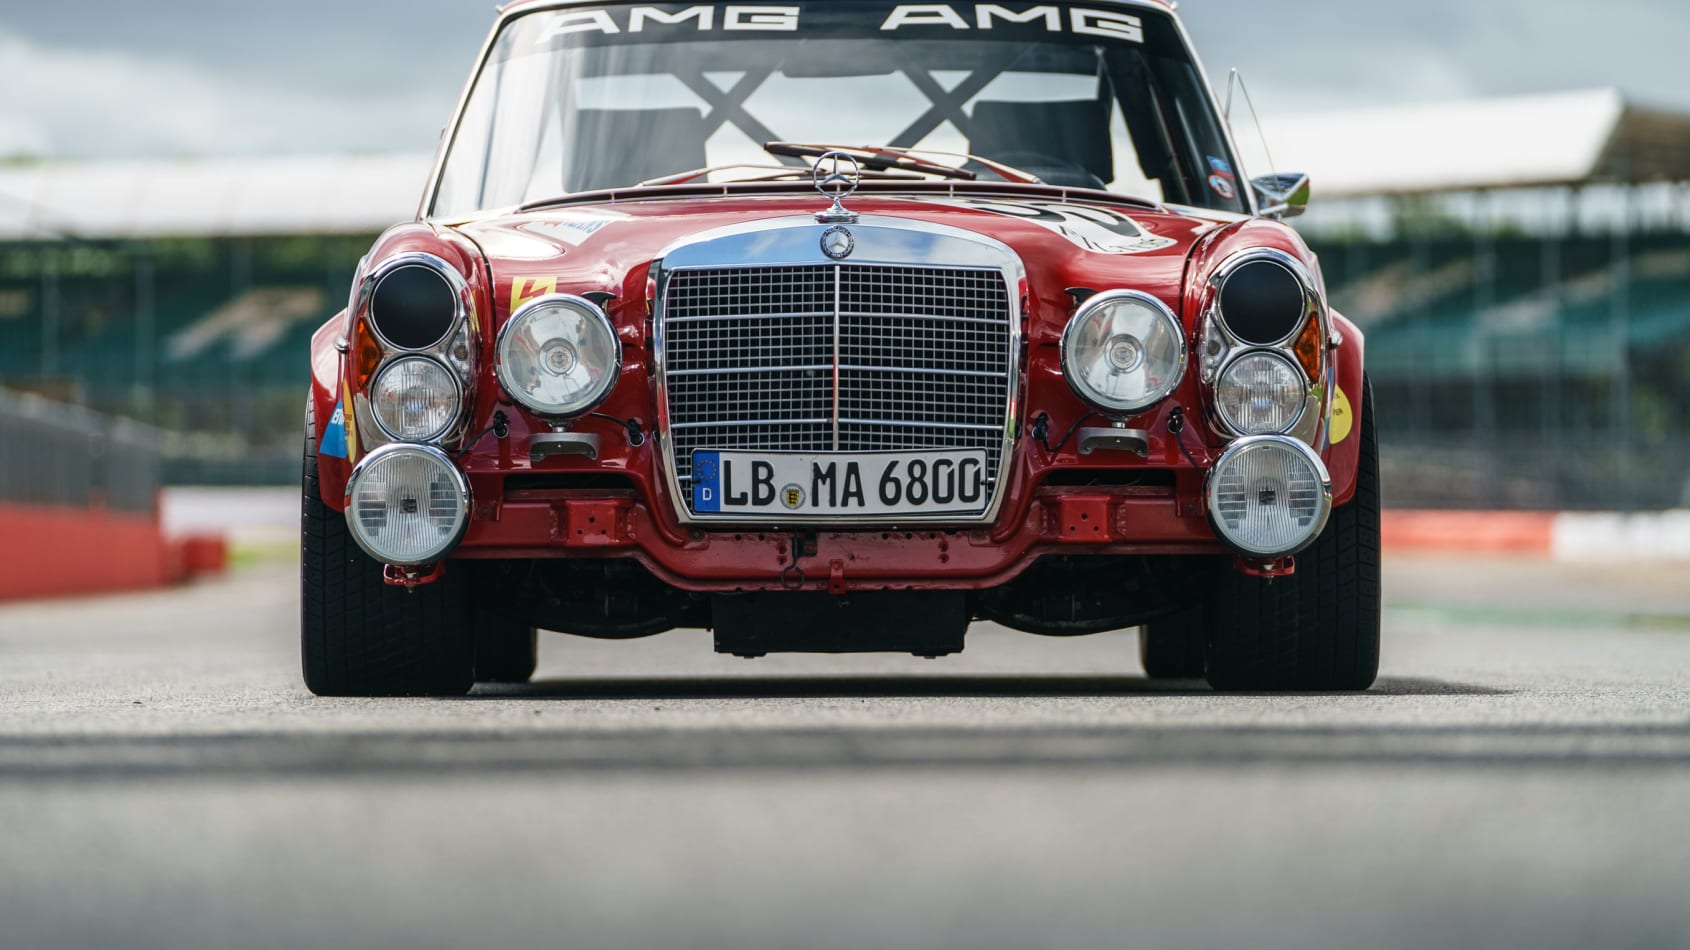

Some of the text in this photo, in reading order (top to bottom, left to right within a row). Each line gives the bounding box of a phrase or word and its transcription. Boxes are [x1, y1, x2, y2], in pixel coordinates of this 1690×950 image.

[535, 4, 1144, 45] AMG AMG
[702, 487, 712, 500] D
[723, 458, 981, 507] LB MA 6800
